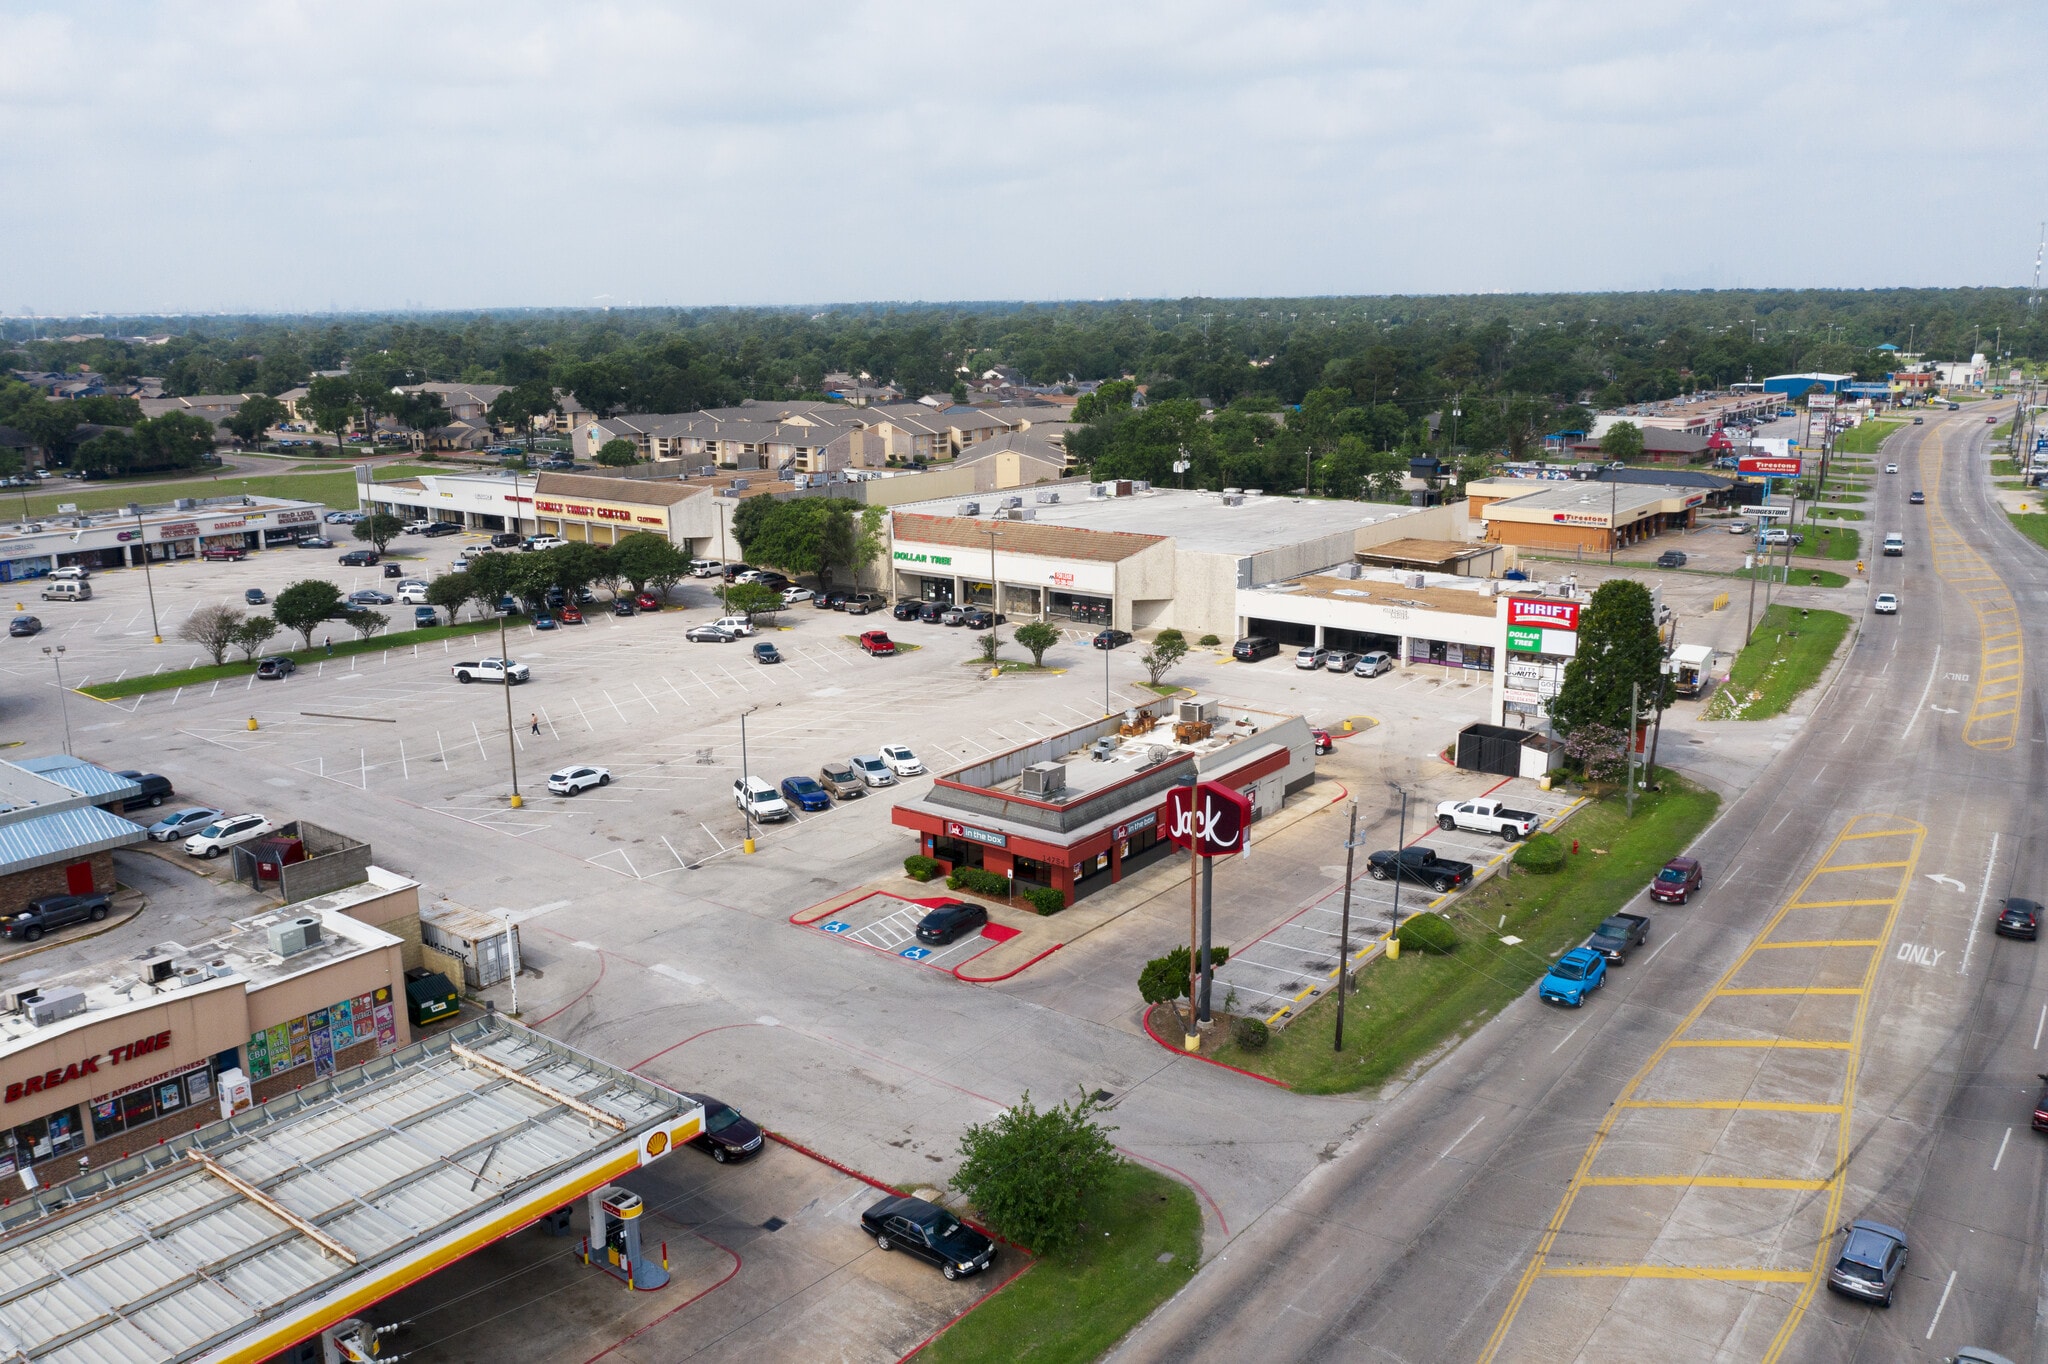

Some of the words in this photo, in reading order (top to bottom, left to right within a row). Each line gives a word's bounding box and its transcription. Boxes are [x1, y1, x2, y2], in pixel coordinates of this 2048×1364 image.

[536, 501, 563, 513] FAMILY
[565, 504, 595, 517] THRIFT
[597, 507, 631, 521] CENTER
[1566, 514, 1609, 523] Firestone
[1743, 507, 1788, 515] BRIDGESTONE
[214, 520, 246, 529] DENTIST
[893, 551, 927, 563] DOLLAR
[930, 555, 952, 566] TREE
[1513, 602, 1574, 619] THRIFT
[1508, 631, 1540, 640] DOLLAR
[1514, 639, 1534, 647] TREE
[1943, 672, 1969, 681] ONLY
[1134, 820, 1144, 830] the
[1144, 815, 1155, 825] box
[1170, 795, 1239, 847] Jack
[965, 828, 973, 837] in
[973, 831, 987, 840] the
[987, 834, 1002, 844] box
[1896, 943, 1946, 966] ONLY
[272, 1040, 285, 1048] AIR
[249, 1048, 267, 1060] CBD
[5, 1054, 101, 1104] BREAK
[109, 1030, 172, 1066] TIME
[93, 1093, 110, 1104] WE
[111, 1072, 169, 1098] APPRECIATE
